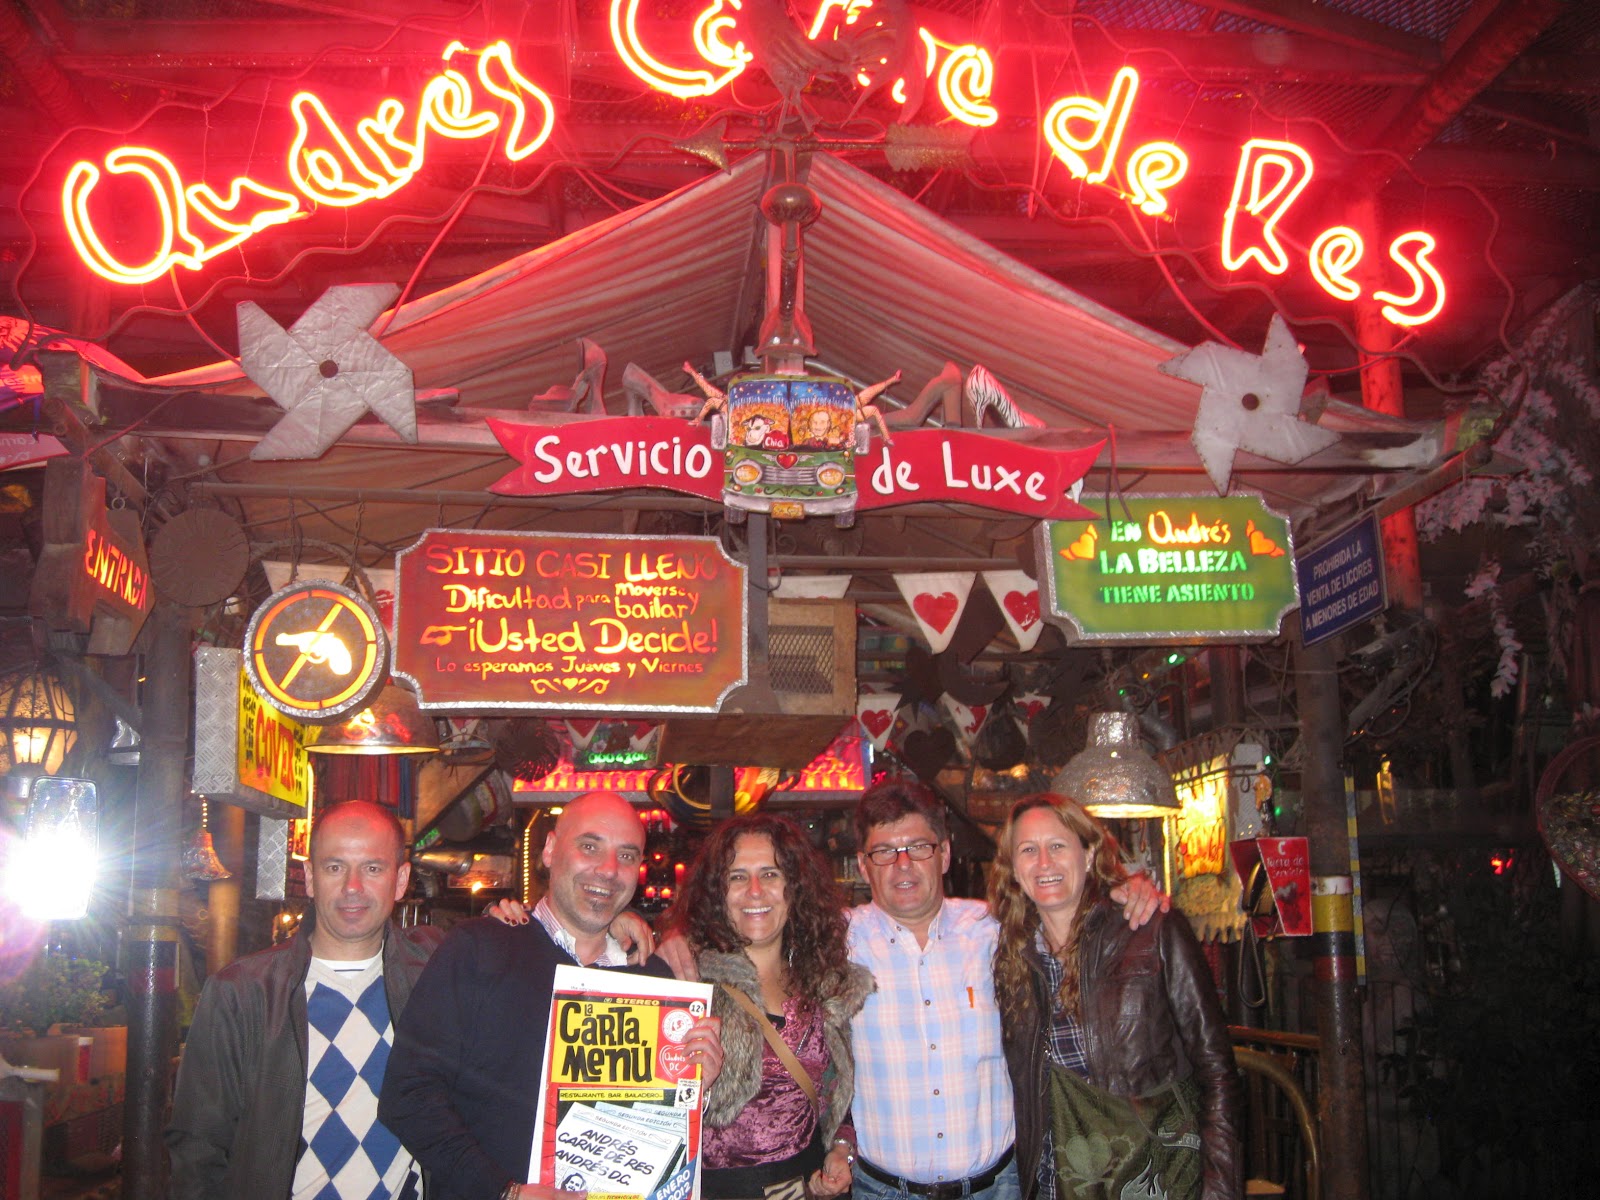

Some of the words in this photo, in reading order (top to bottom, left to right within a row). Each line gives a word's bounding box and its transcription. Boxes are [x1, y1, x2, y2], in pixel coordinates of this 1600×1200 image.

[609, 0, 998, 128] Cae
[1043, 66, 1190, 216] de
[1221, 138, 1448, 327] Res
[534, 434, 713, 484] Servicio
[871, 446, 921, 495] de
[941, 440, 1047, 501] Luxe
[85, 529, 147, 611] ENTRADA
[426, 545, 526, 577] SITIO
[535, 550, 612, 580] CASI
[622, 552, 718, 582] LLENO
[1100, 550, 1133, 574] LA
[1137, 547, 1248, 574] BELLEZA
[1313, 547, 1351, 580] PROHIBIDA
[1352, 540, 1363, 559] LA
[1101, 584, 1162, 604] TIENE
[1166, 582, 1255, 602] ASIENTO
[1306, 585, 1331, 607] VENTA
[1331, 576, 1341, 595] DE
[1341, 558, 1373, 586] LICORES
[443, 583, 572, 613] Dificultad
[614, 595, 689, 619] bailar
[1305, 616, 1312, 632] A
[1312, 602, 1347, 628] MENORES
[1347, 592, 1359, 611] DE
[1360, 580, 1379, 606] EDAD
[589, 617, 719, 654] Decide!
[436, 656, 457, 673] Lo
[463, 658, 554, 681] esperamos
[627, 662, 636, 678] y
[641, 657, 704, 674] Viernes
[255, 705, 295, 791] COVER
[616, 997, 660, 1006] STEREO
[594, 1115, 621, 1128] SEGUNDA
[621, 1124, 648, 1137] EDICIÓN
[617, 1111, 645, 1122] SEGUNDA
[645, 1118, 672, 1127] EDICIÓN
[655, 1108, 682, 1118] SEGUNDA
[558, 1132, 604, 1155] CARNE
[603, 1150, 622, 1164] DE
[624, 1158, 655, 1175] RES
[580, 1129, 638, 1156] ANDRÉS
[555, 1149, 609, 1176] ANDRÉS
[656, 1169, 691, 1200] ENERO
